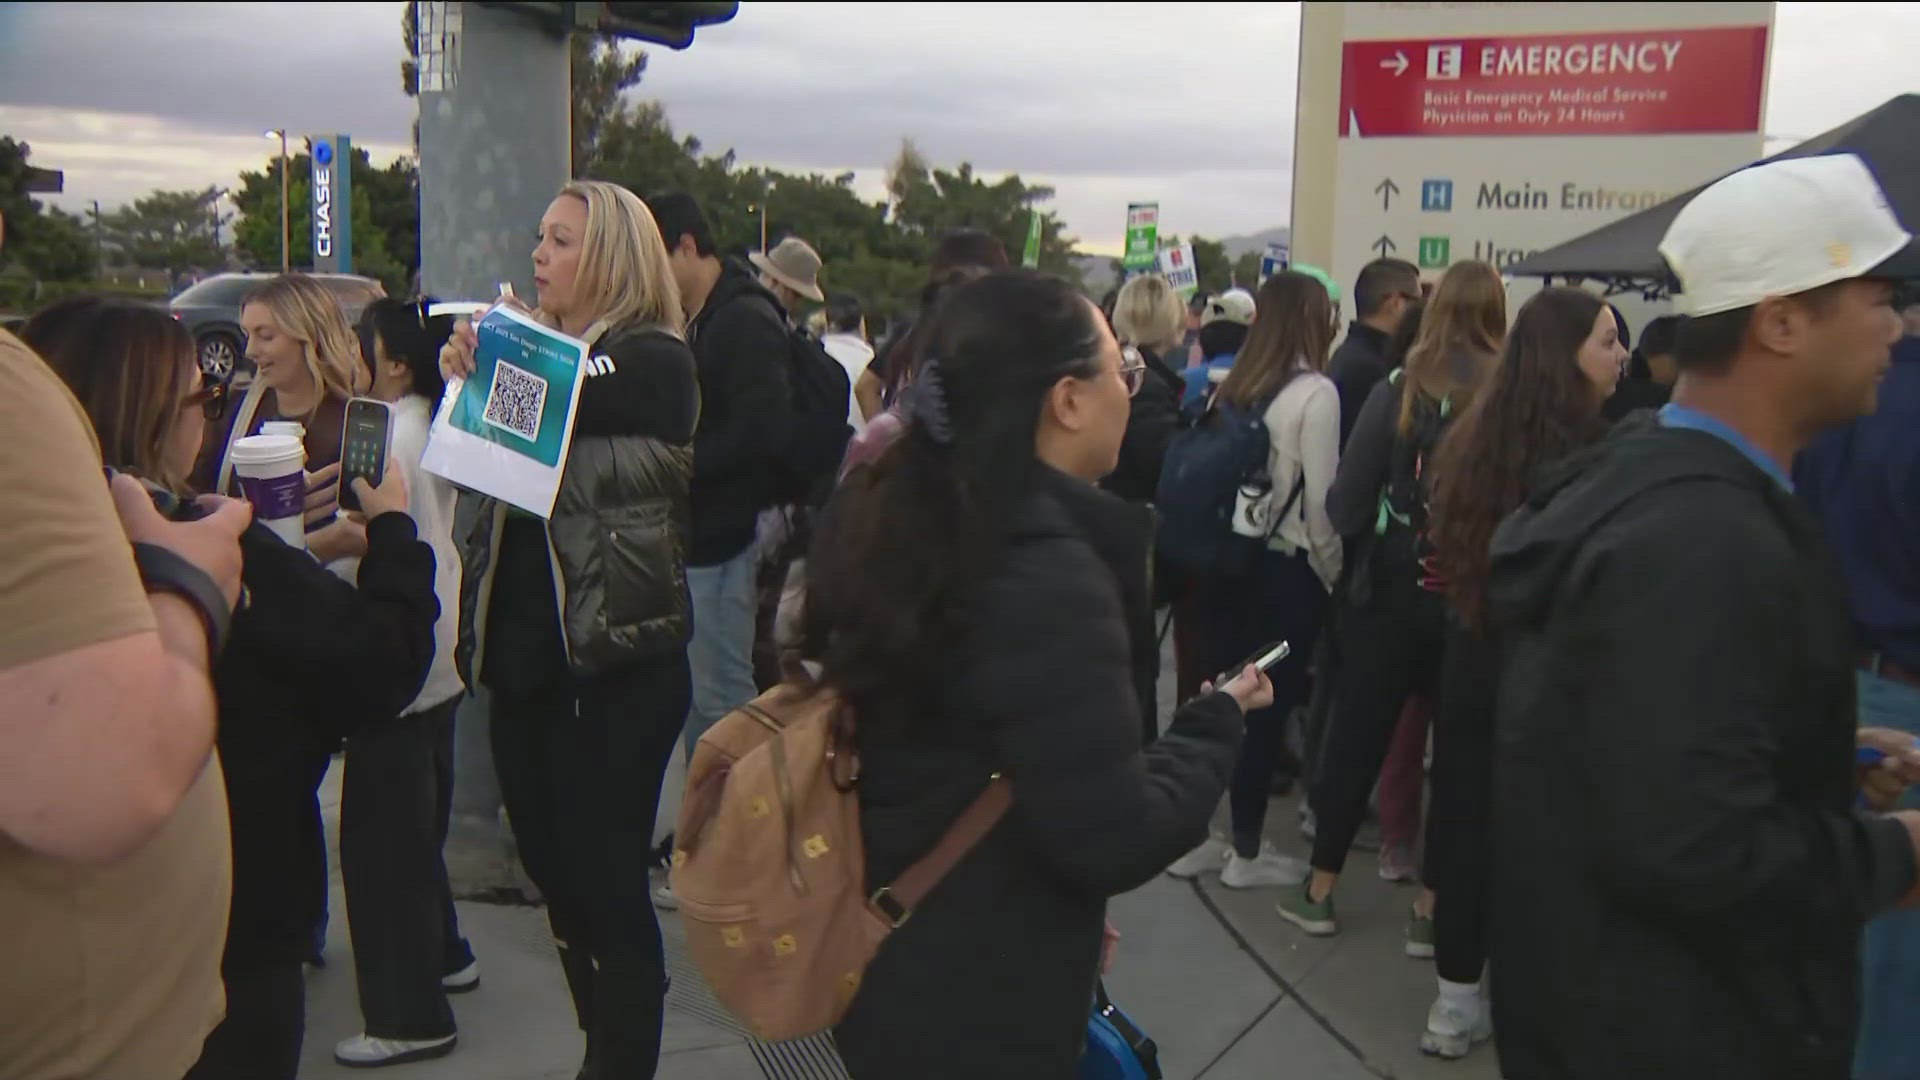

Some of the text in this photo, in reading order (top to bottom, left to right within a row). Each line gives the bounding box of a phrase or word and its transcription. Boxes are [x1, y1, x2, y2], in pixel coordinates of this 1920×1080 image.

[1480, 42, 1682, 77] EMERGENCY
[1424, 87, 1668, 107] Basic Emergency Medical Service
[1423, 108, 1625, 125] Physician on Duty 24 Hours
[1427, 185, 1446, 207] H
[1476, 182, 1548, 210] Main
[316, 169, 331, 257] CHASE
[1425, 240, 1444, 265] U
